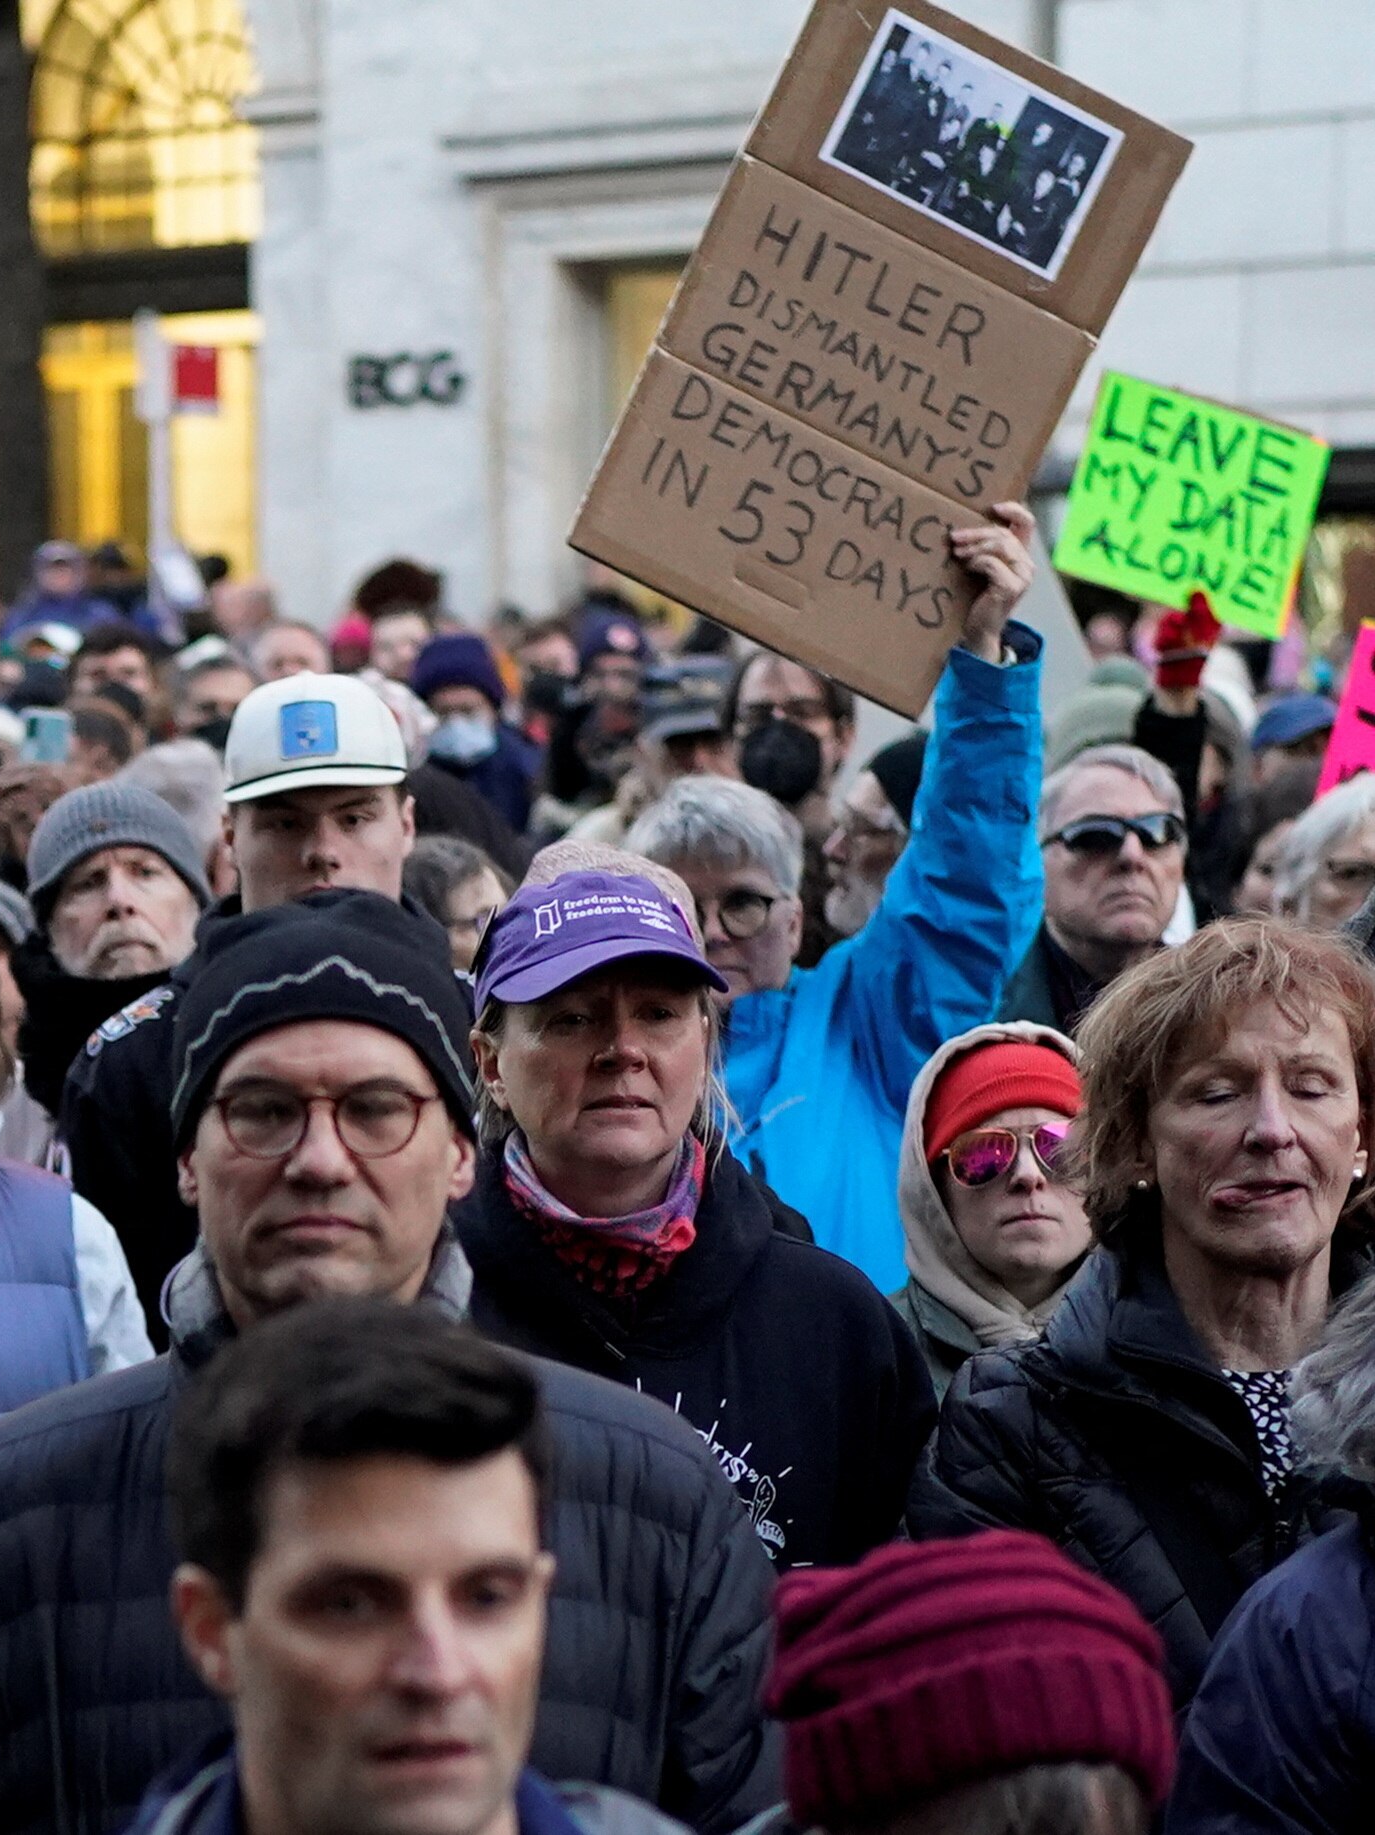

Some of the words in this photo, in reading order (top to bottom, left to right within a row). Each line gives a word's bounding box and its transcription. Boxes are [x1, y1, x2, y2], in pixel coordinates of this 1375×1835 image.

[754, 204, 986, 367] HITLER
[348, 350, 466, 409] BCG
[702, 321, 996, 498] GERMANY'S
[727, 269, 1012, 450] DISMANTLED
[1100, 382, 1298, 497] LEAVE
[641, 435, 710, 508] IN
[717, 477, 816, 566] 53
[824, 539, 953, 630] DAYS
[1083, 451, 1159, 522] MY
[1170, 479, 1290, 565] DATA
[563, 894, 623, 911] freedom
[623, 895, 636, 905] to
[565, 905, 626, 921] freedom
[627, 904, 641, 914] to
